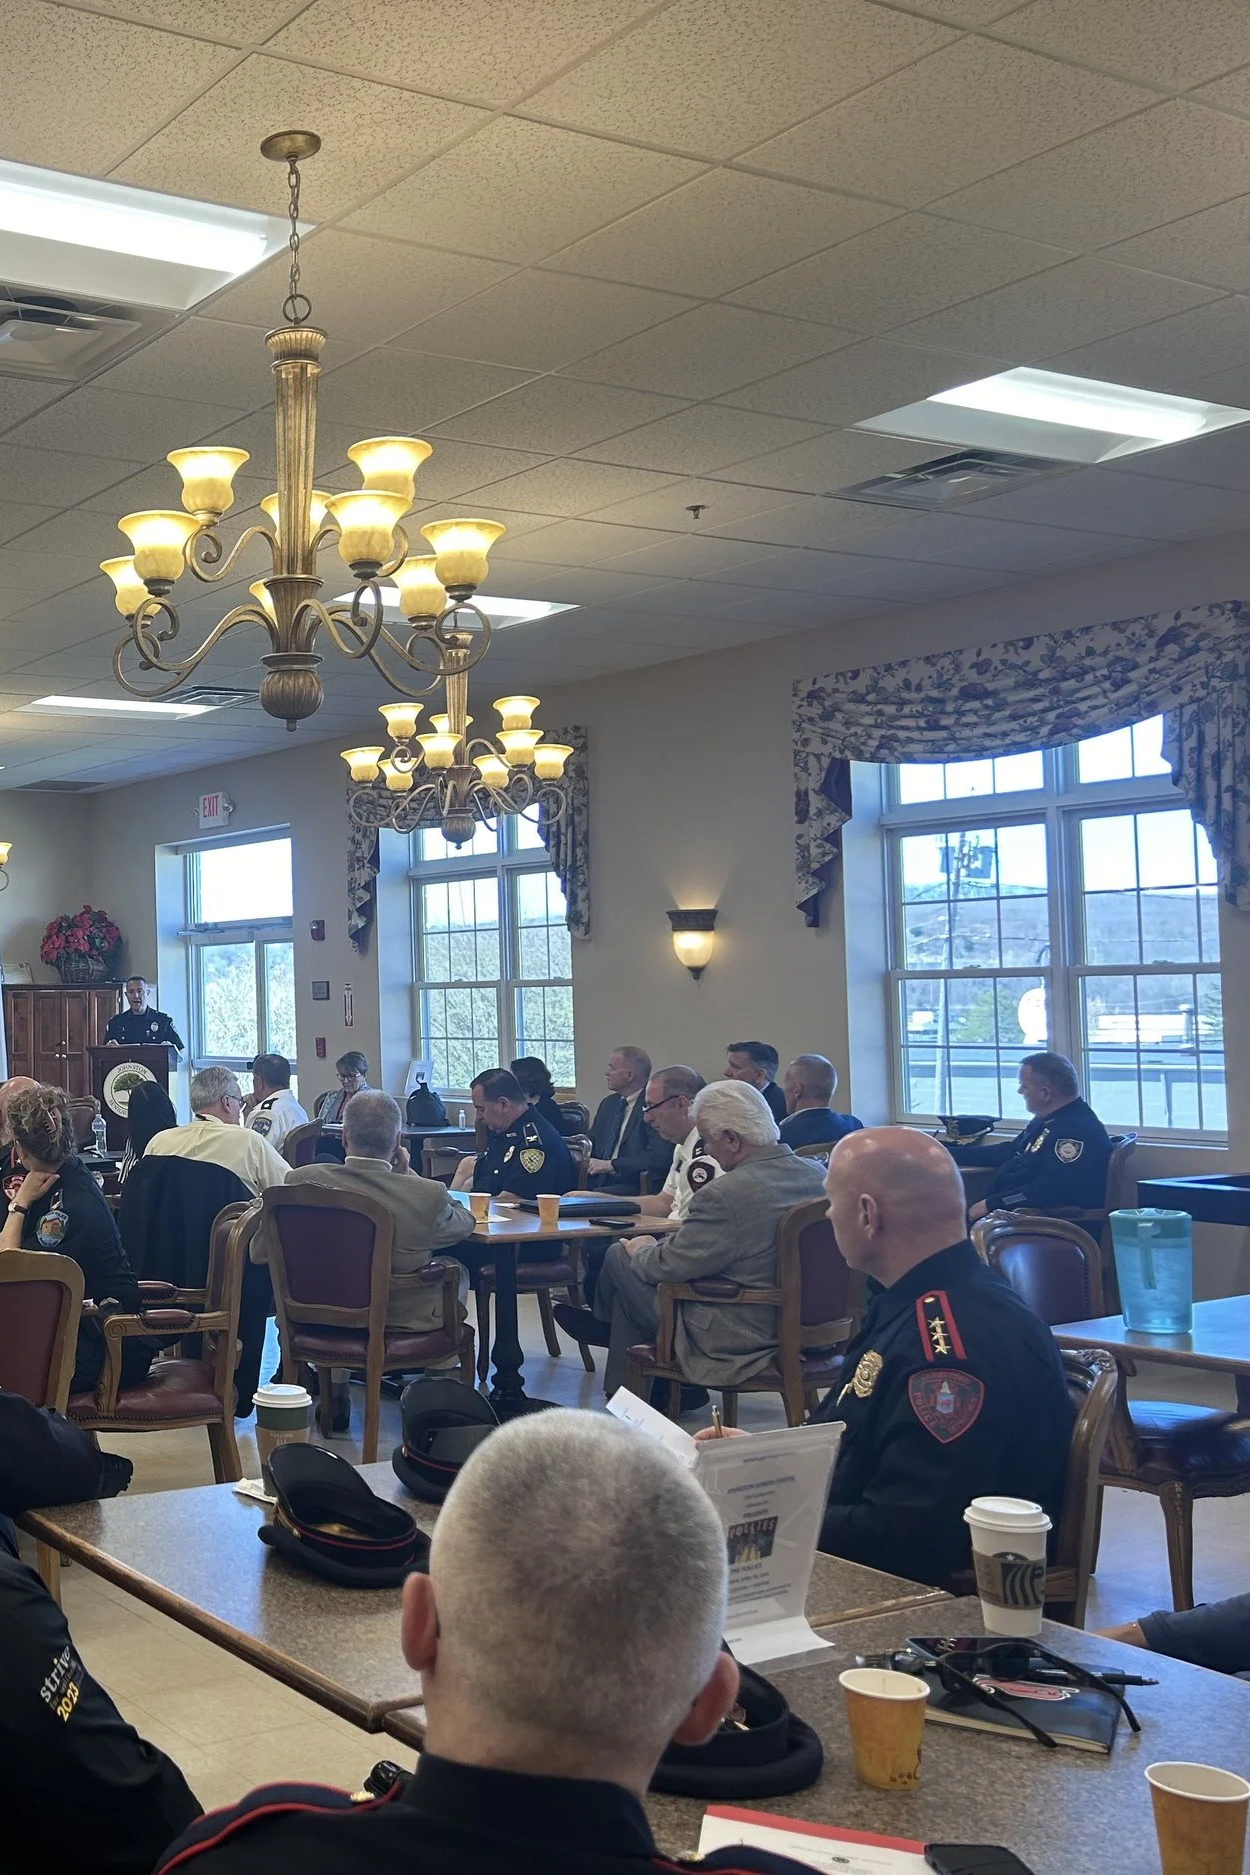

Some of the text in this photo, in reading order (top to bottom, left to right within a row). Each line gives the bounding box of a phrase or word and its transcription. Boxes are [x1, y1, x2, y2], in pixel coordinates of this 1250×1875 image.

[203, 795, 219, 818] EXIT
[117, 1064, 147, 1075] JOHNSTON
[730, 1518, 775, 1539] FOLLIES
[40, 1645, 71, 1703] strive
[57, 1681, 79, 1722] 2023
